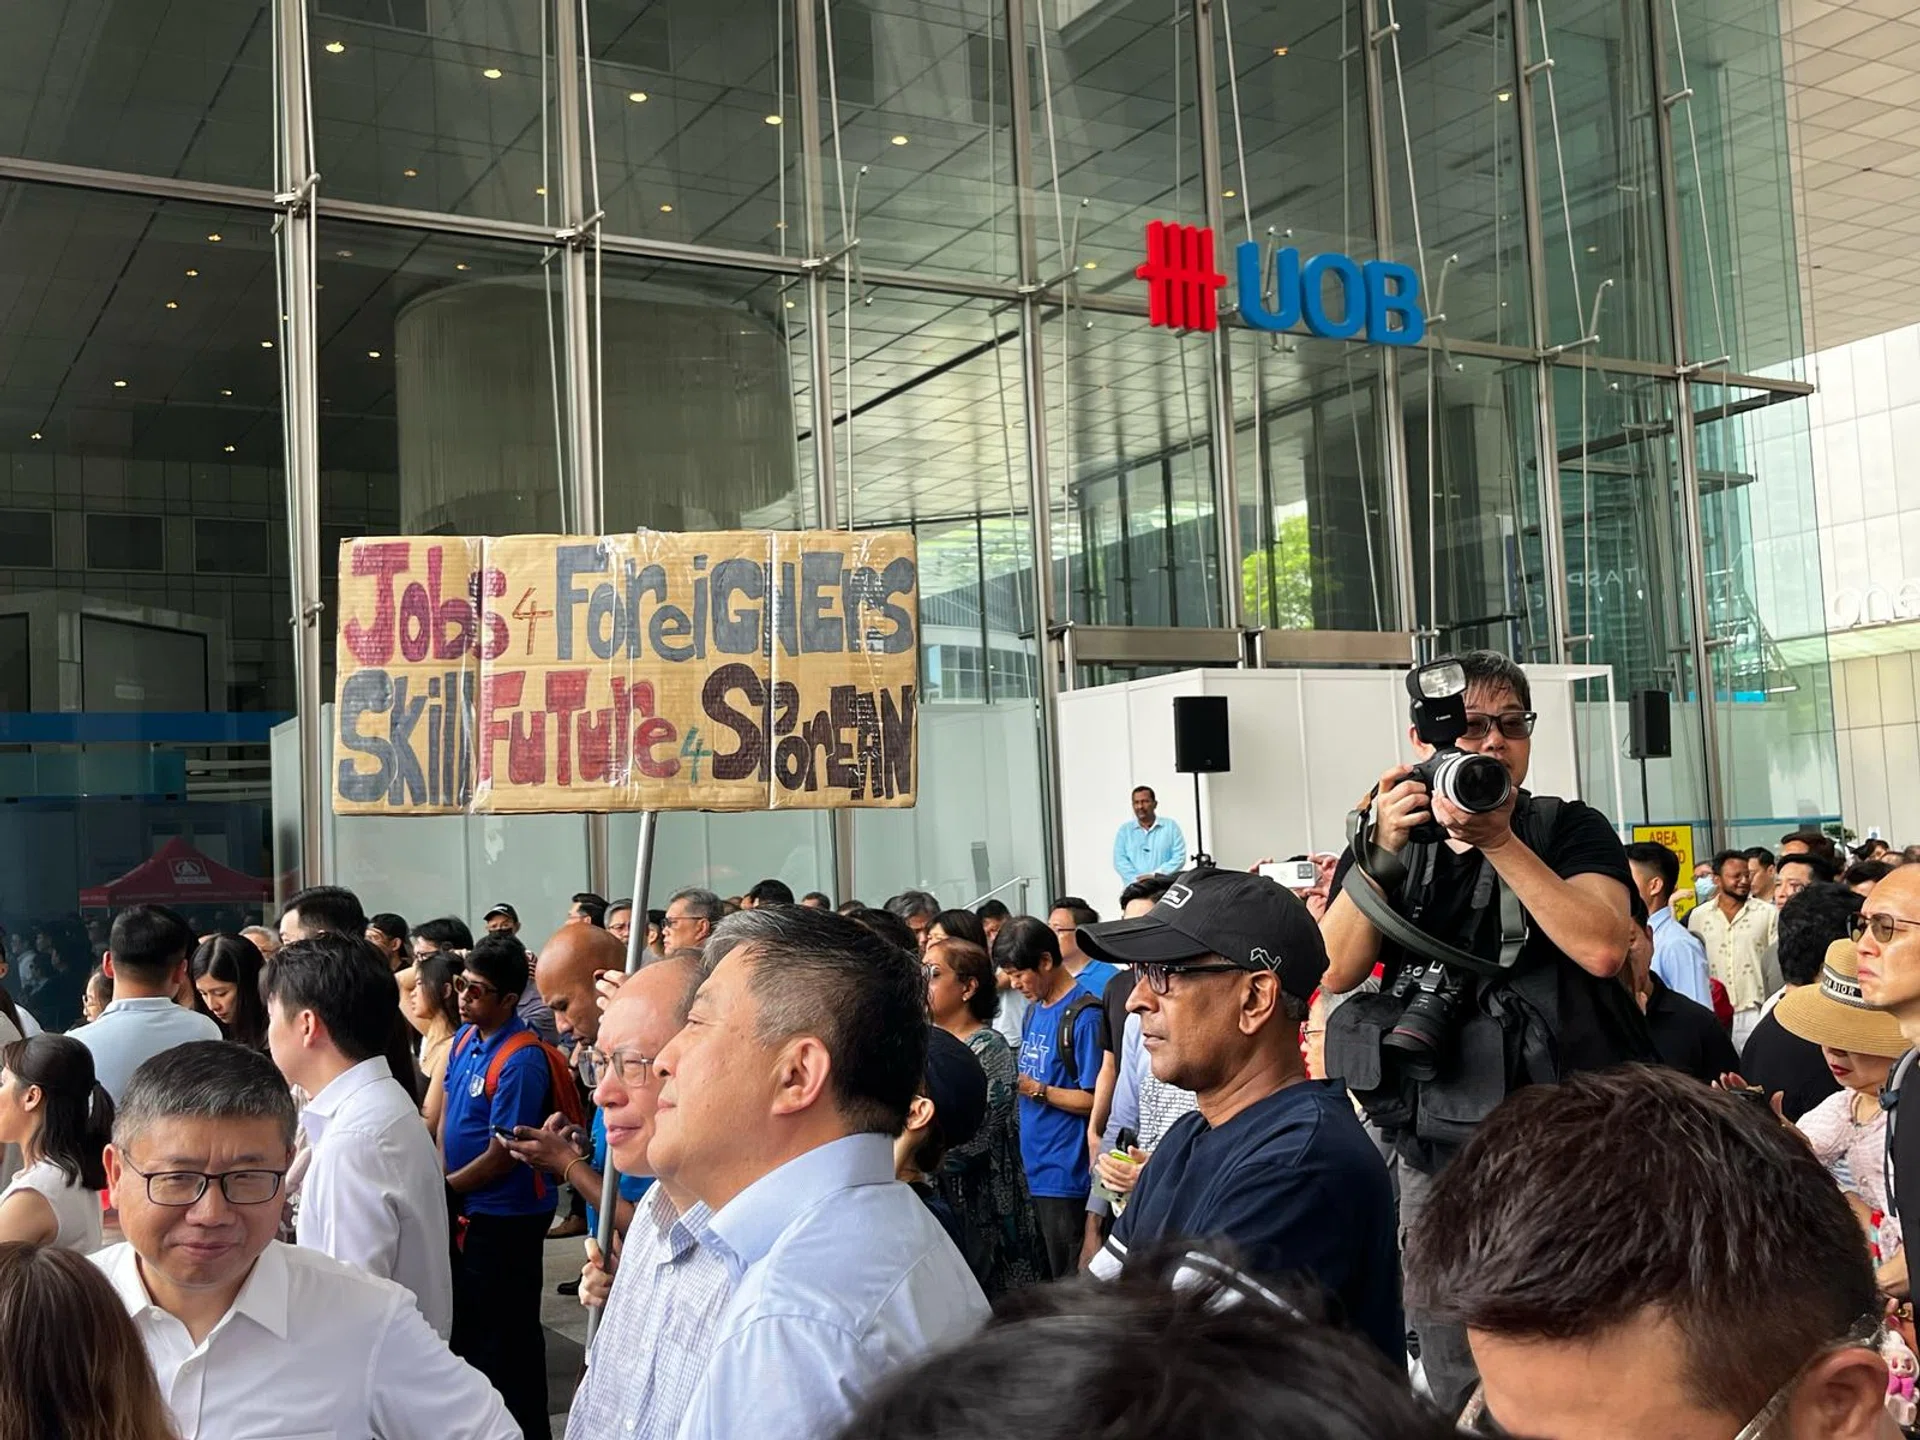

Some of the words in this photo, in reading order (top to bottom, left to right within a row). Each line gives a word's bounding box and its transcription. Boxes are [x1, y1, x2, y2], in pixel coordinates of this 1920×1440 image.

[1236, 241, 1425, 345] UOB
[344, 543, 510, 666] Jobs
[512, 586, 554, 656] 4
[680, 725, 712, 784] 4
[1649, 831, 1678, 845] AREA
